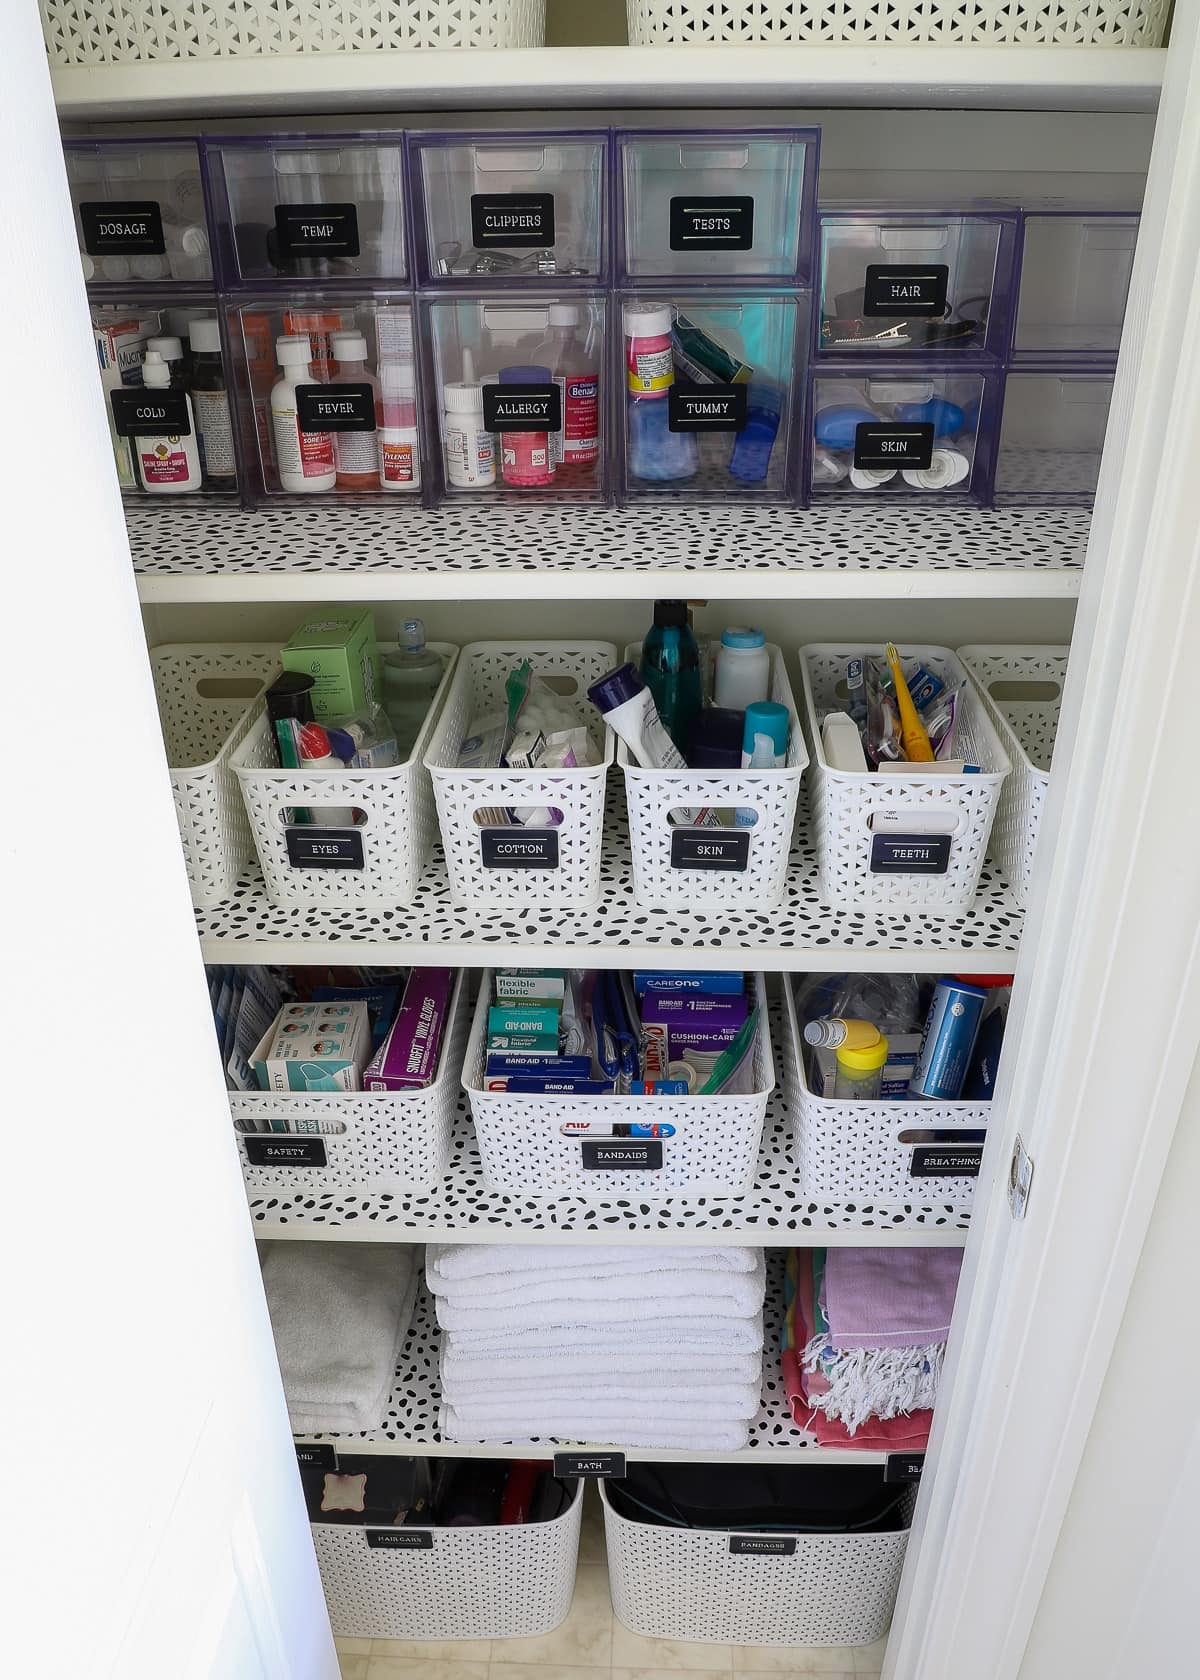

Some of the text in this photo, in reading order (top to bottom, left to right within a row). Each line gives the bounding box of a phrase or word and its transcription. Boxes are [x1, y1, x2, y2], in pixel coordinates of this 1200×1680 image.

[485, 214, 542, 227] CLIPPERS
[692, 218, 731, 230] TESTS
[99, 223, 148, 235] DOSAGE
[301, 225, 334, 237] TEMP
[891, 285, 921, 297] HAIR
[136, 407, 167, 418] COLD
[318, 402, 355, 414] FEVER
[496, 403, 549, 414] ALLERGY
[686, 403, 729, 414] TUMMY
[881, 441, 908, 452] SKIN
[311, 844, 339, 854] EYES
[497, 844, 543, 854] COTTON
[696, 845, 724, 856] SKIN
[892, 849, 930, 859] TEETH
[500, 979, 536, 987] flexible
[500, 987, 529, 995] fabric
[505, 1021, 543, 1030] BAND-AID
[671, 1033, 735, 1041] CUSHION-CARE
[406, 1043, 424, 1073] SNUGFIT
[266, 1147, 306, 1156] SAFETY
[597, 1151, 648, 1159] BANDAIDS
[923, 1158, 981, 1166] BREATHING
[577, 1462, 603, 1470] BATH
